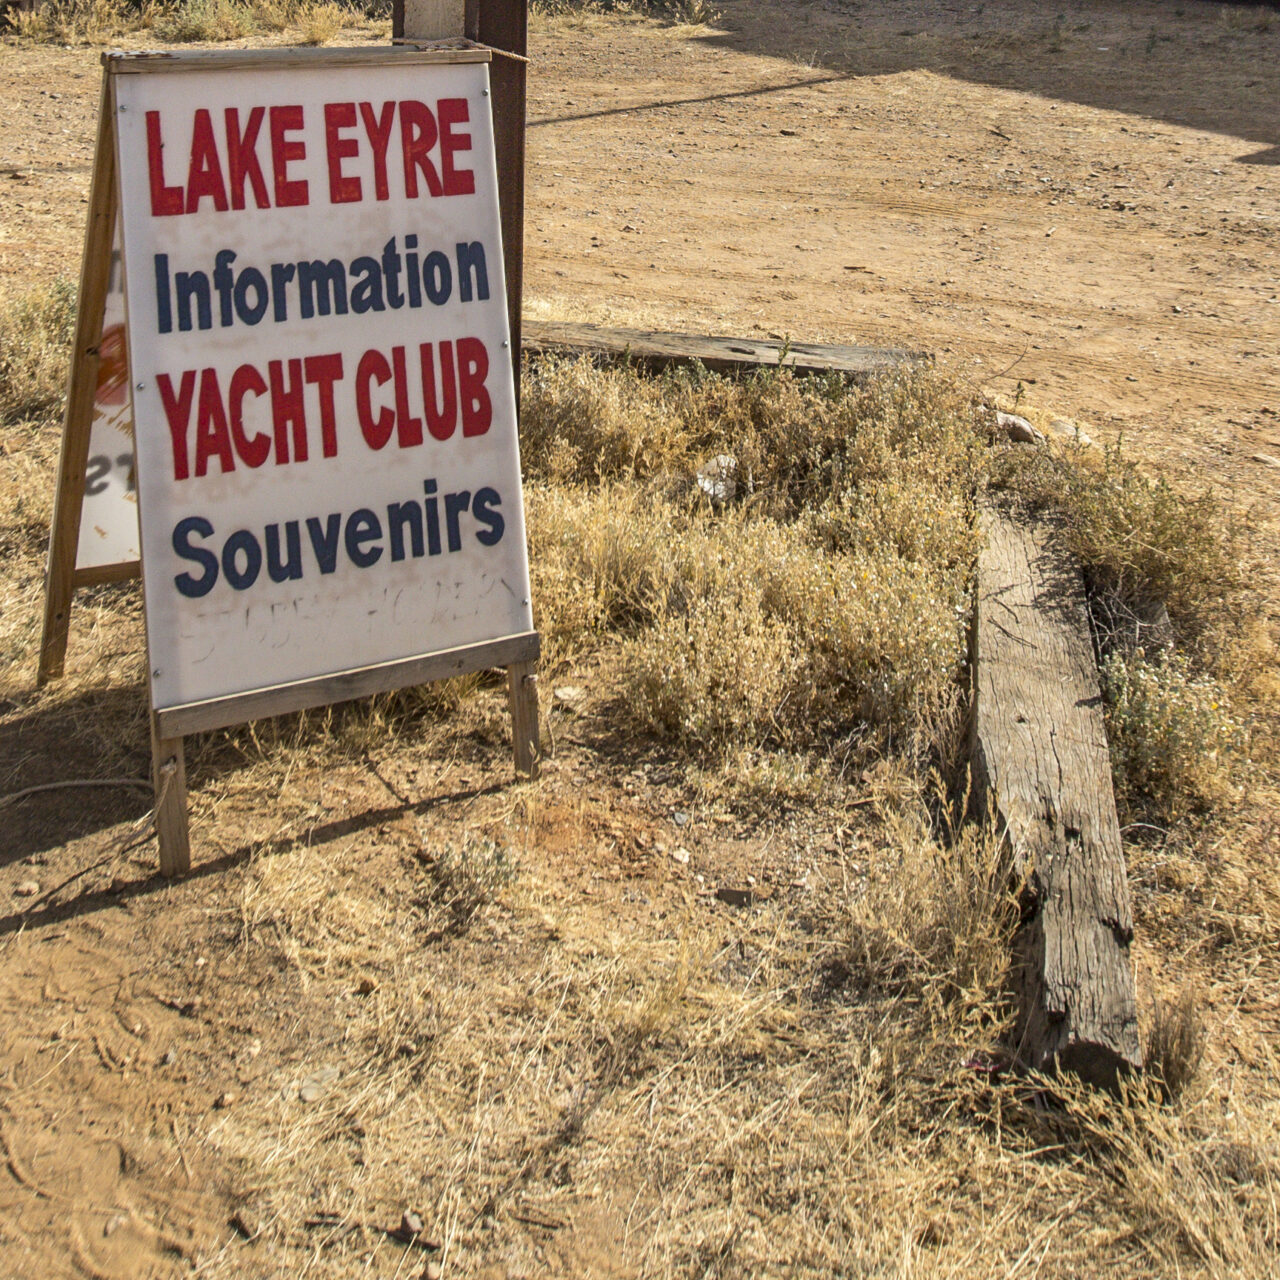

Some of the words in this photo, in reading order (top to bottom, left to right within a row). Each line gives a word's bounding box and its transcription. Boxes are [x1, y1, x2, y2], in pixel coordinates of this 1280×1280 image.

[144, 104, 310, 217] LAKE
[324, 97, 476, 204] EYRE
[153, 233, 491, 334] Information
[155, 351, 344, 482] YACHT
[354, 335, 494, 452] CLUB
[171, 478, 507, 599] Souvenirs
